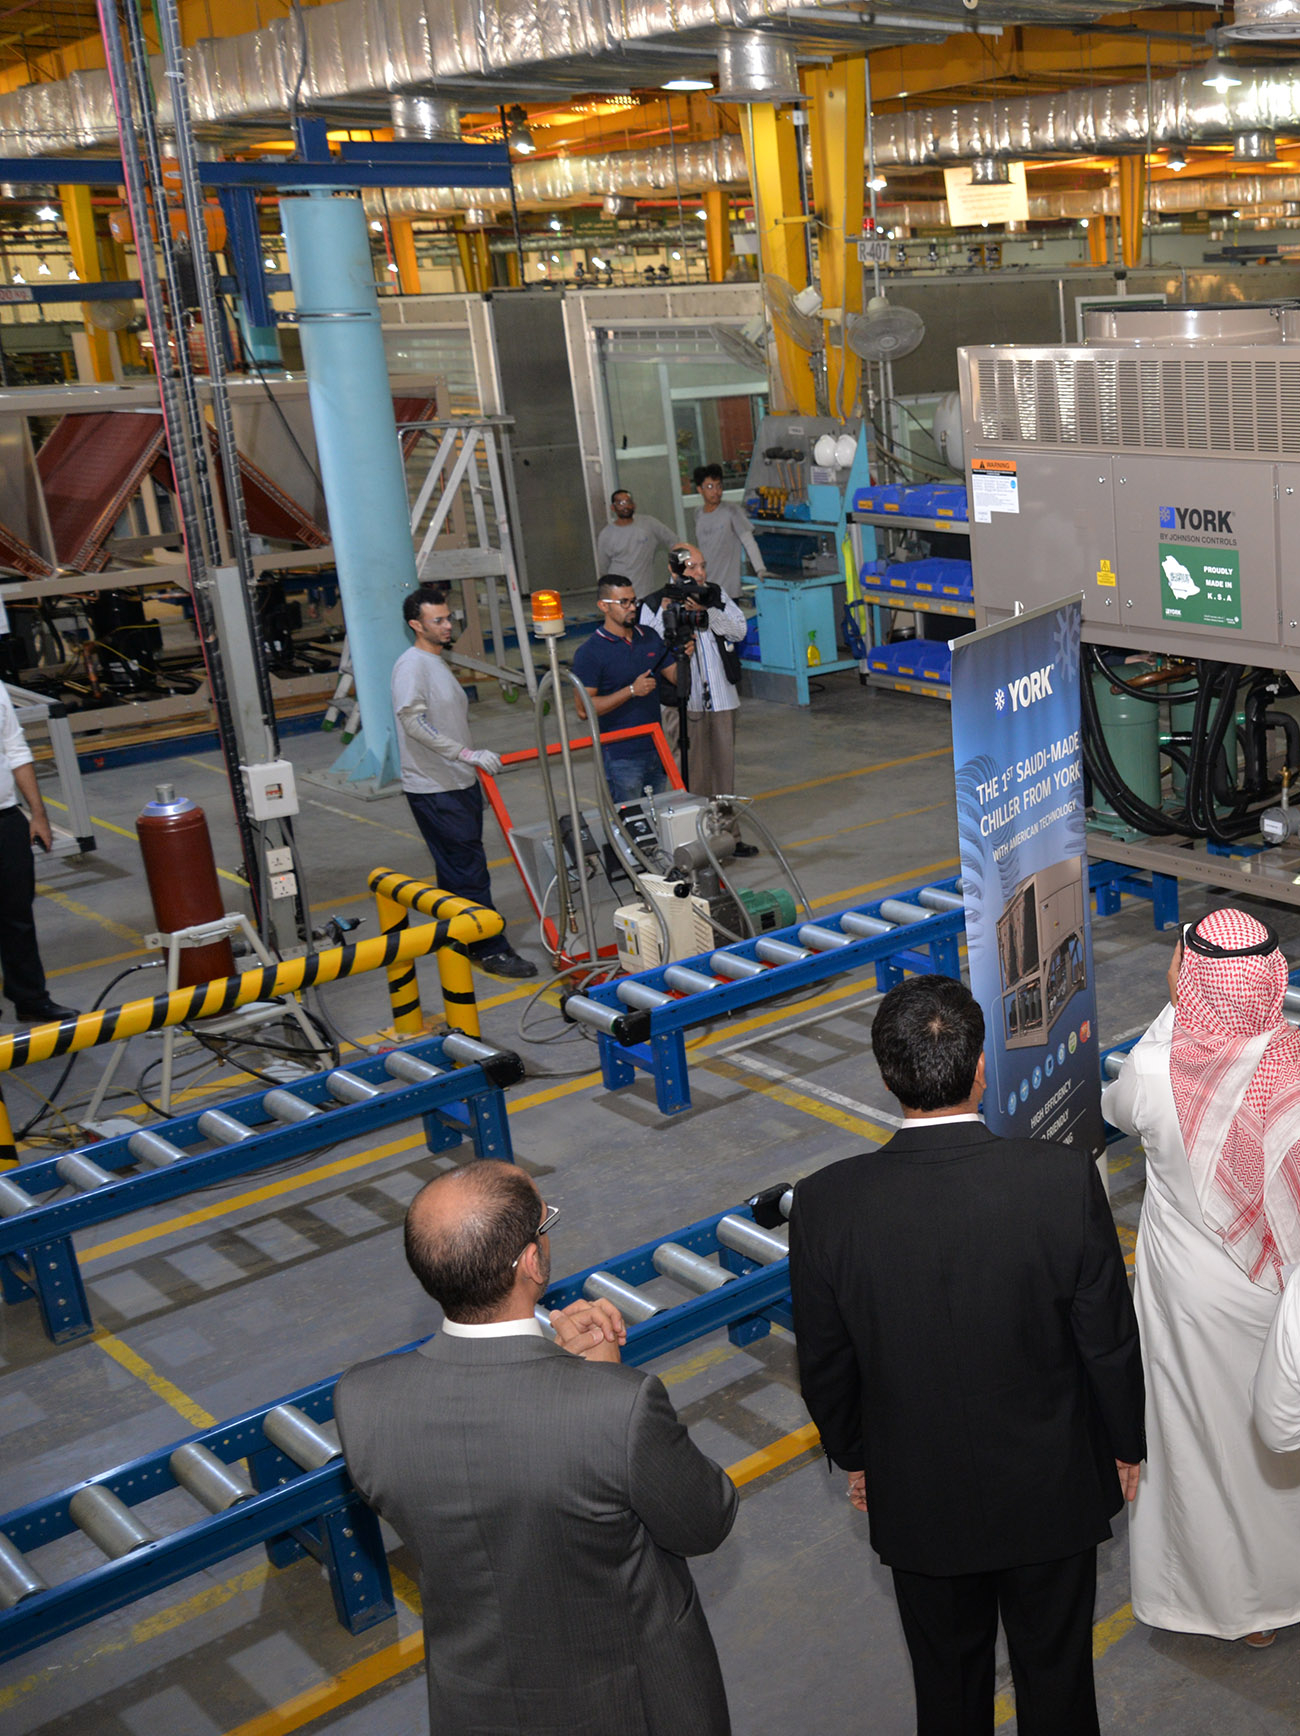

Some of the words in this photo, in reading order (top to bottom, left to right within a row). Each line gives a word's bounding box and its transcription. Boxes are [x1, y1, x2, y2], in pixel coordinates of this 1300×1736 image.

[859, 242, 888, 260] R-407
[1176, 508, 1233, 534] YORK
[1169, 534, 1200, 543] JOHNSON
[1201, 536, 1237, 546] CONTROLS
[1204, 566, 1233, 575] PROUDLY
[1205, 579, 1224, 588] MADE
[1225, 581, 1233, 589] IN
[1008, 665, 1053, 712] YORK
[976, 776, 999, 805] THE
[1015, 731, 1079, 783] SAUDI-MADE
[980, 802, 1021, 837] CHILLER
[1023, 777, 1051, 810] FROM
[1053, 760, 1080, 790] YORK
[992, 842, 1009, 862] WITH
[1008, 823, 1039, 850] AMERICAN
[1039, 799, 1076, 829] TECHNOLOGY
[1030, 1107, 1044, 1129] HIGH
[1044, 1078, 1072, 1115] EFFICIENCY
[1046, 1108, 1069, 1141] FRIENDLY
